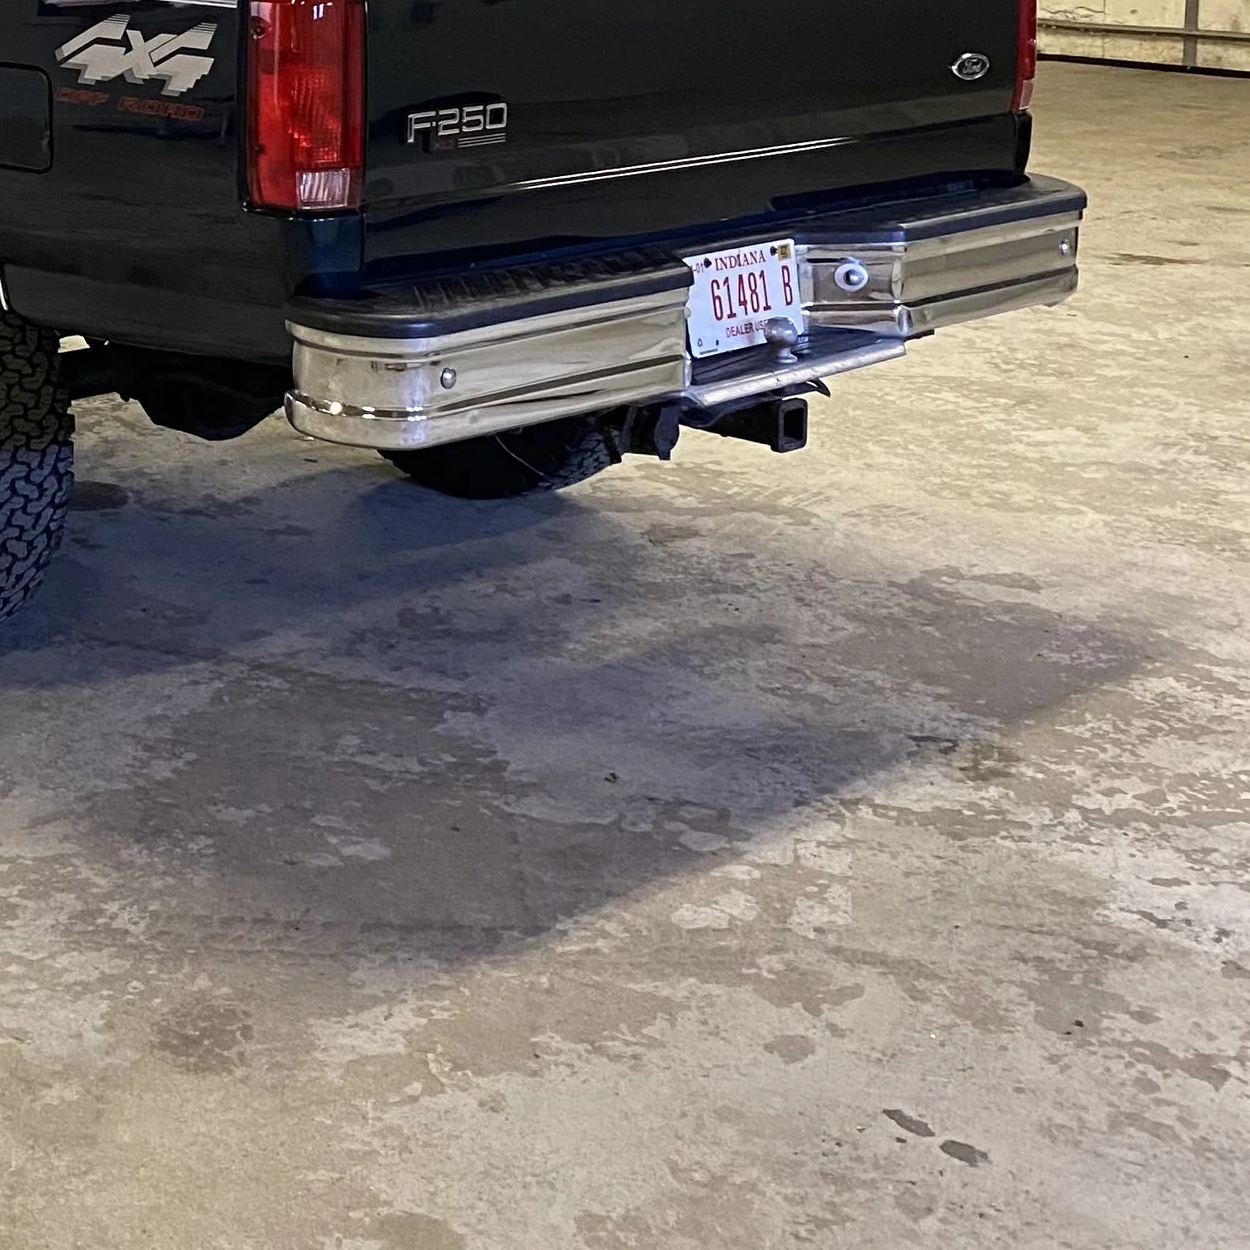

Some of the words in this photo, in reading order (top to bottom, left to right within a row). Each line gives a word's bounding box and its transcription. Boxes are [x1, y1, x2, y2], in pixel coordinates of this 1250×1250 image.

[117, 96, 205, 121] ROAD
[407, 102, 508, 143] F-250
[714, 249, 767, 272] INDIANA
[710, 269, 772, 321] 61481
[781, 265, 794, 307] B
[725, 322, 755, 338] DEALER
